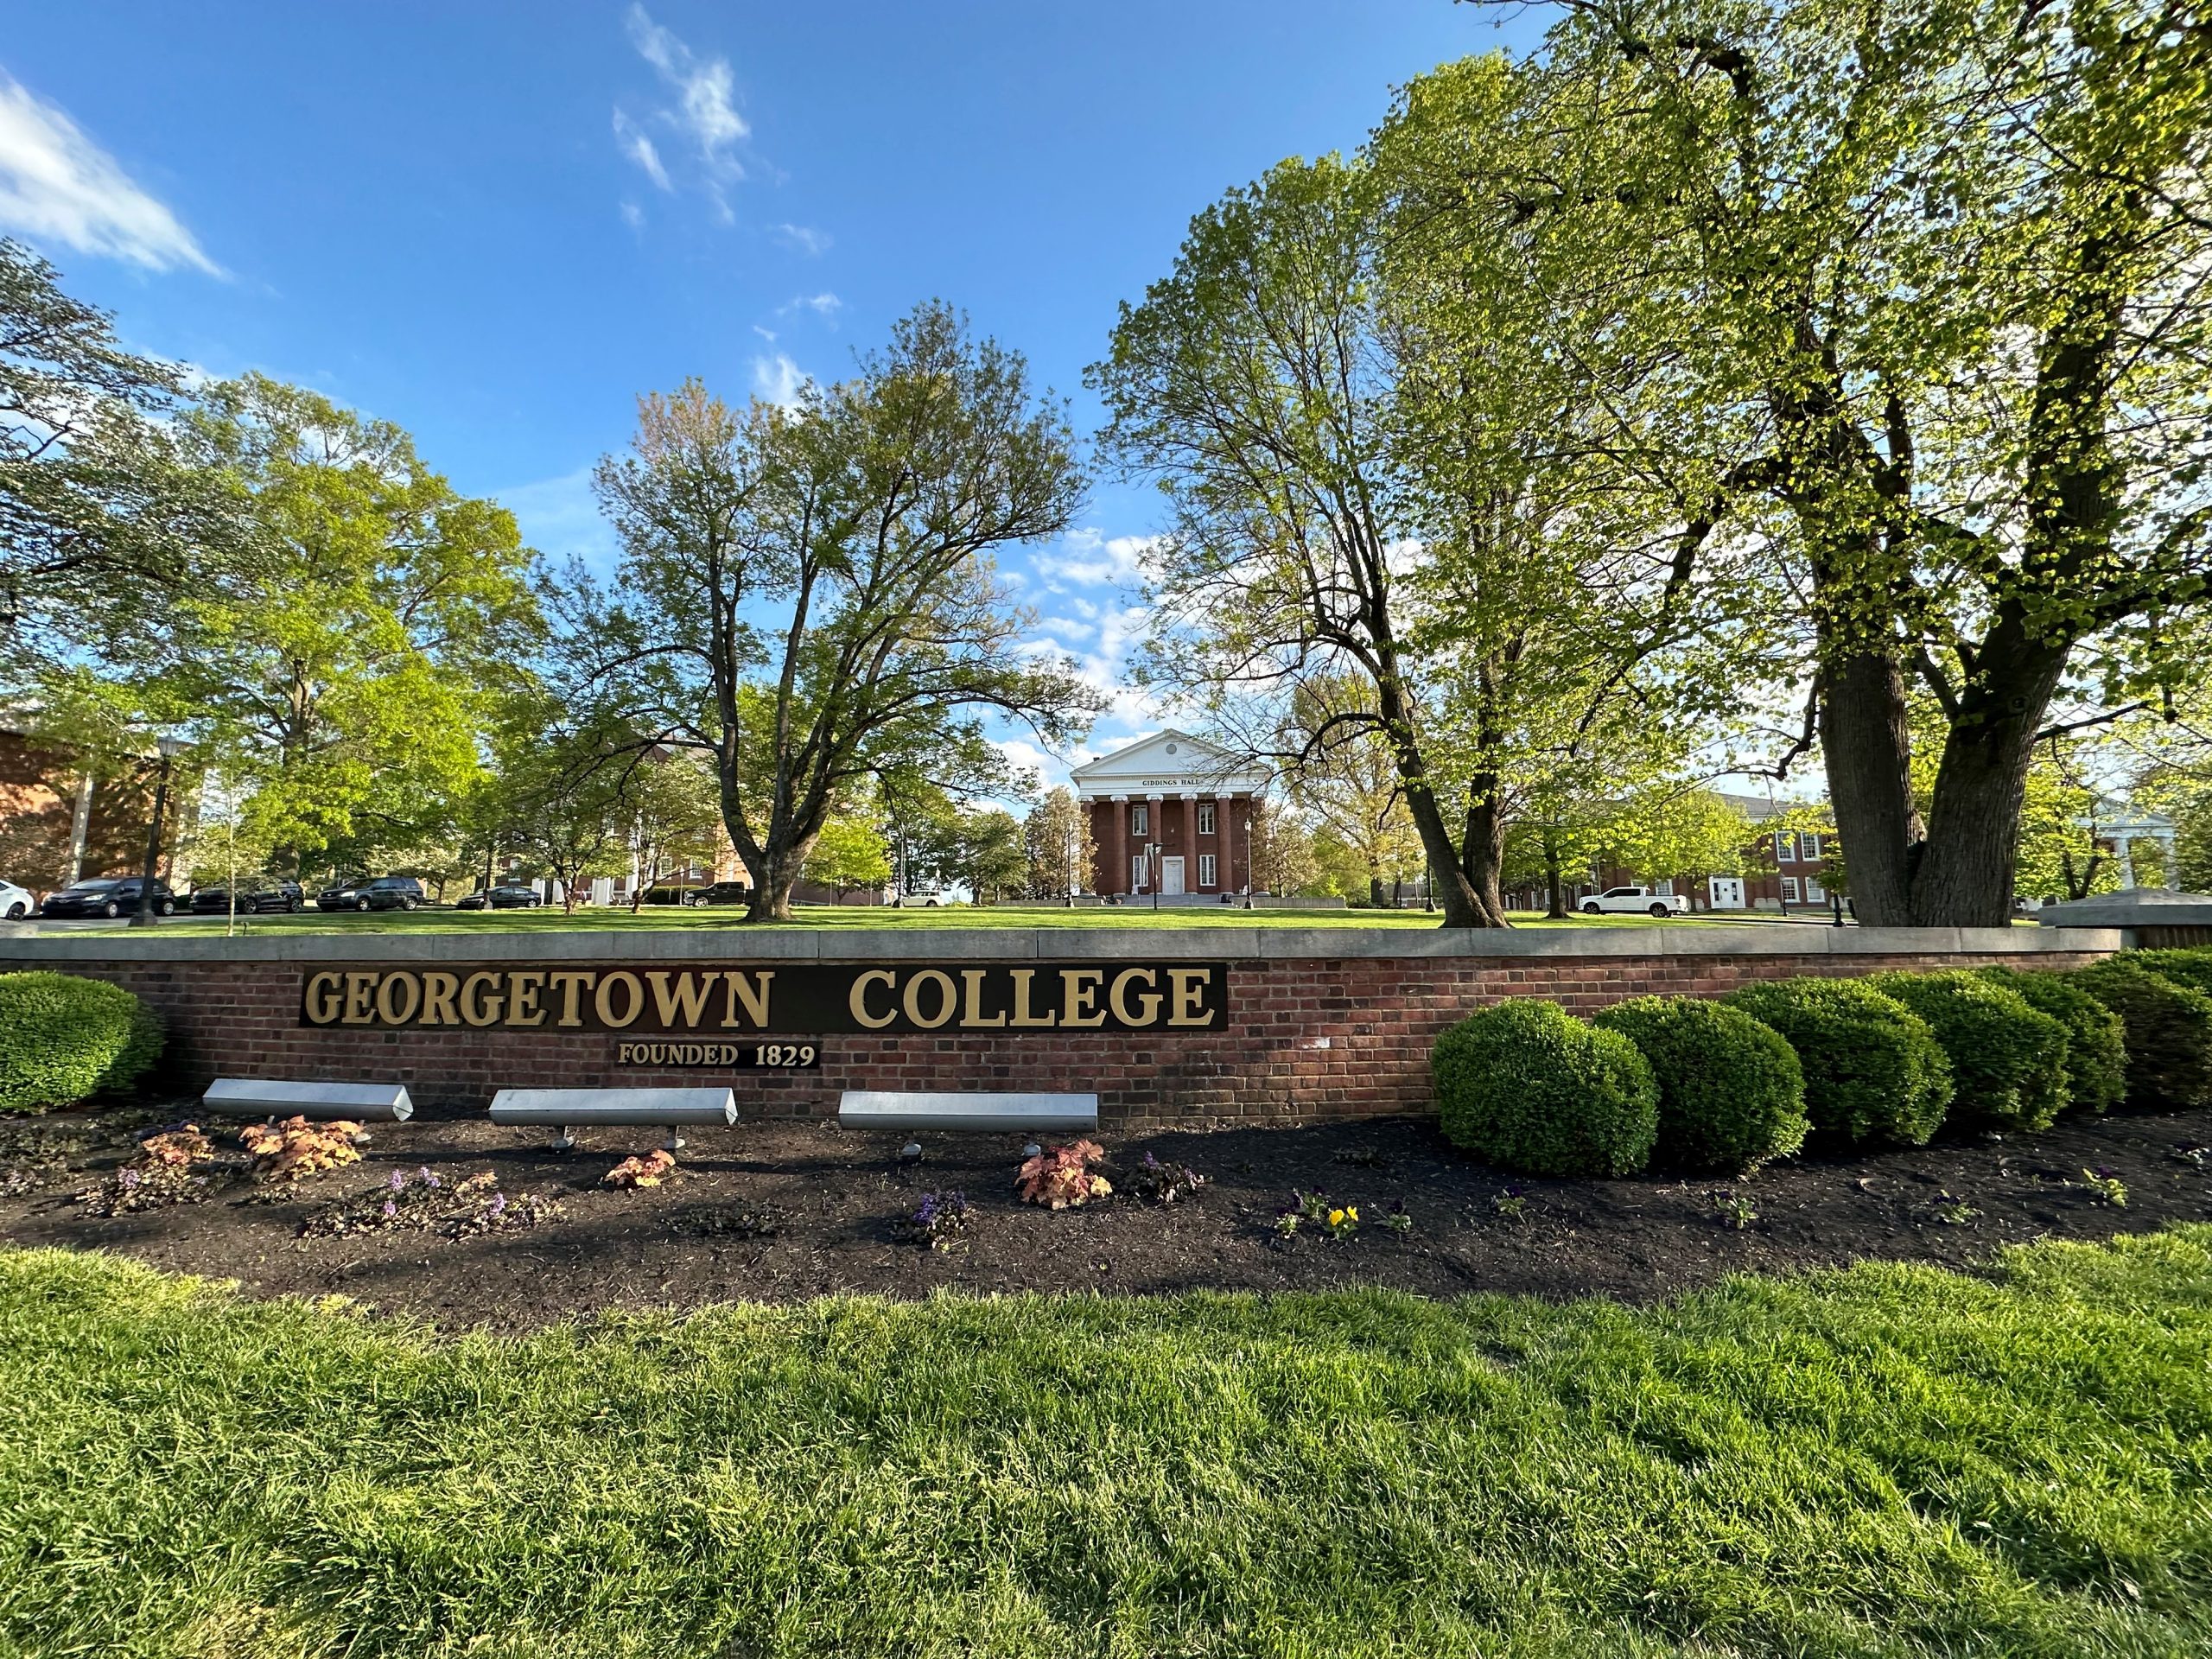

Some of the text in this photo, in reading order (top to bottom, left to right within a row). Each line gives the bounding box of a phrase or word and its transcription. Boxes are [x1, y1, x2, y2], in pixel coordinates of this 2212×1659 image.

[305, 967, 1216, 1029] GEORGETOWN COLLEGE
[618, 1043, 816, 1067] FOUNDED 1829
